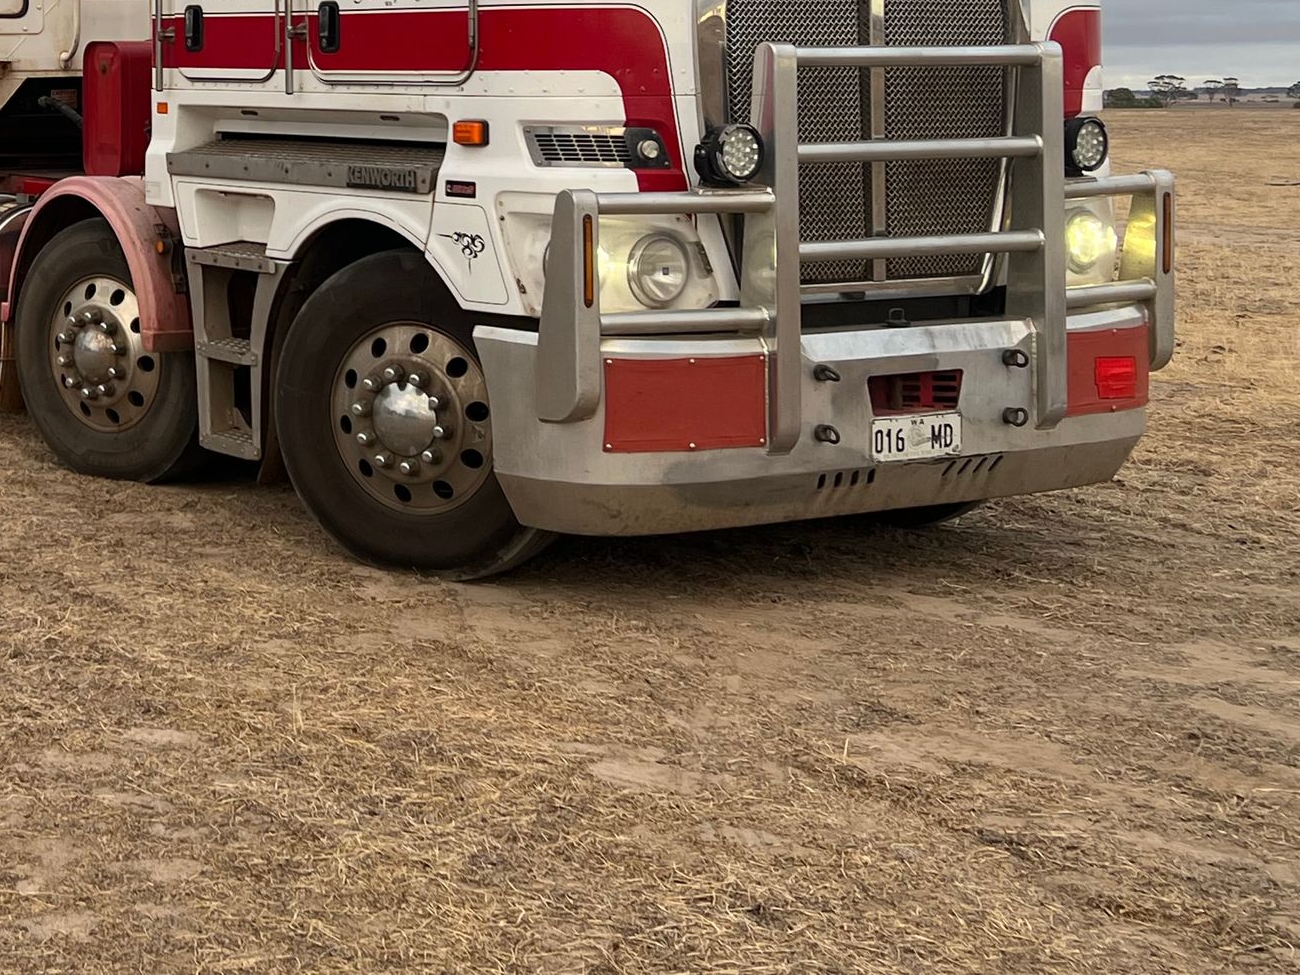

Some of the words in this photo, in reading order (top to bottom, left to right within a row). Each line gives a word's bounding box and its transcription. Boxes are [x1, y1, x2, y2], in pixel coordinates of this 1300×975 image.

[347, 165, 415, 187] KENWORTH
[875, 428, 904, 453] 016
[931, 423, 953, 449] MD
